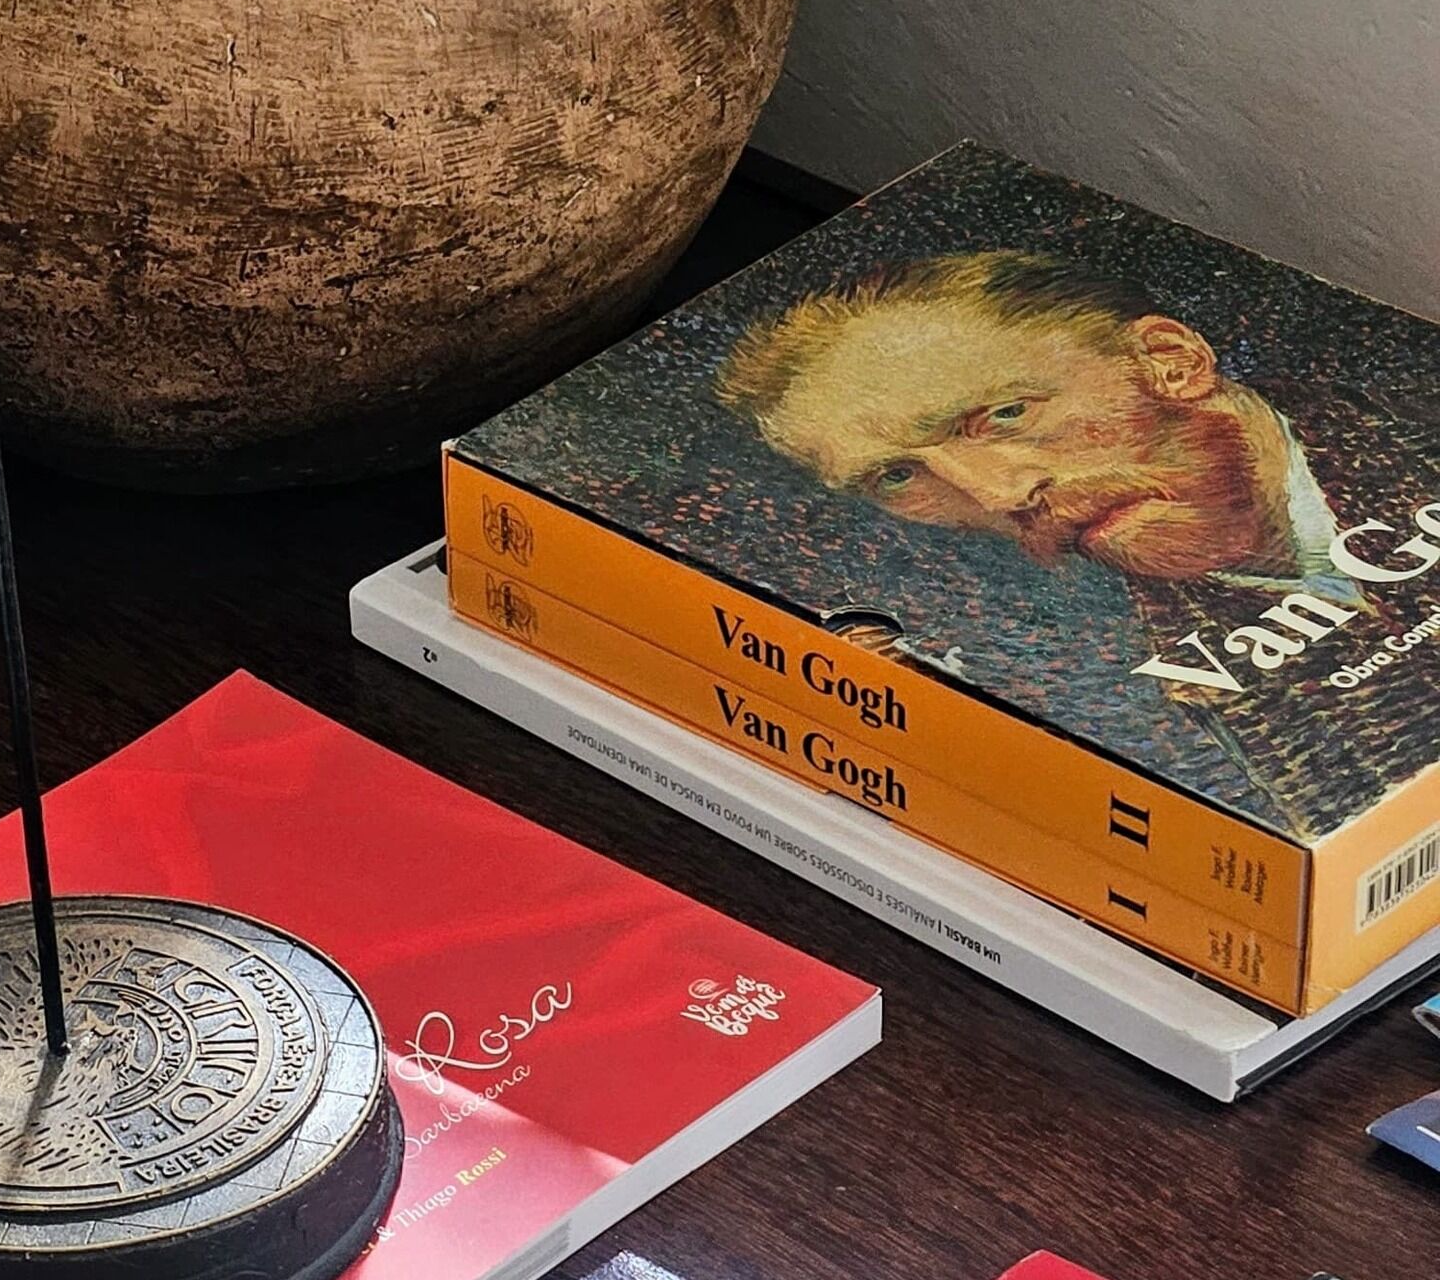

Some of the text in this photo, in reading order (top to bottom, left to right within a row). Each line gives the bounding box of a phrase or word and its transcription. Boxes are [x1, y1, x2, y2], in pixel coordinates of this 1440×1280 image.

[1130, 593, 1359, 693] Van
[712, 604, 788, 676] Van
[801, 649, 909, 733] Gogh
[1329, 645, 1394, 689] Obra
[566, 725, 627, 766] IDENTIDADE
[713, 683, 789, 755] Van
[802, 730, 909, 812] Gogh
[628, 758, 652, 780] UMA
[653, 770, 669, 789] DE
[669, 780, 704, 808] BUSCA
[705, 799, 722, 819] EM
[723, 808, 754, 835] POVO
[753, 823, 772, 844] UM
[773, 833, 808, 863] SOBRE
[808, 853, 875, 900] DISCUSSÕES
[944, 923, 982, 957] BRASIL
[981, 945, 1002, 965] UM
[395, 980, 573, 1096] Rosa
[133, 1096, 288, 1184] BRASILEIRA
[454, 1145, 508, 1187] Rossi
